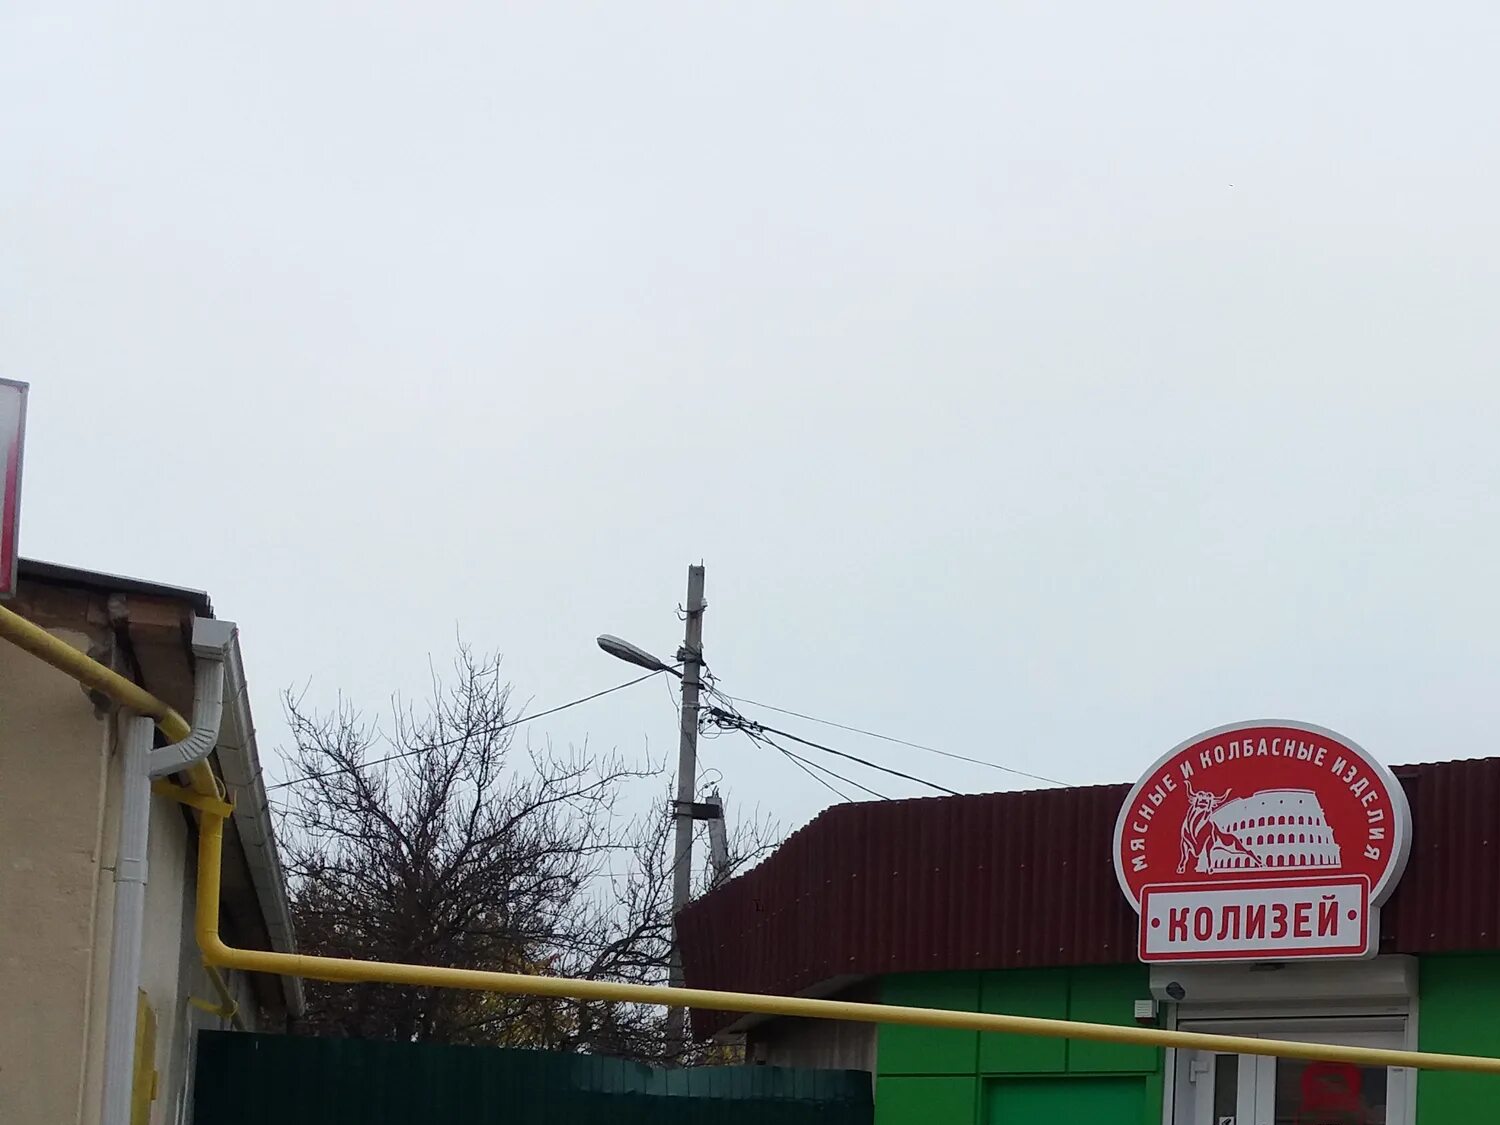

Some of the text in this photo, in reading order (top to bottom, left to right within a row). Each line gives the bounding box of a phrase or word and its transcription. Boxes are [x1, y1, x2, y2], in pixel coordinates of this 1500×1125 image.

[1130, 738, 1386, 872] МЯСНЫЕ И КОЛБАСНЫЕ ИЗДЕЛИЯ
[1168, 894, 1339, 942] КОЛИЗЕЙ
